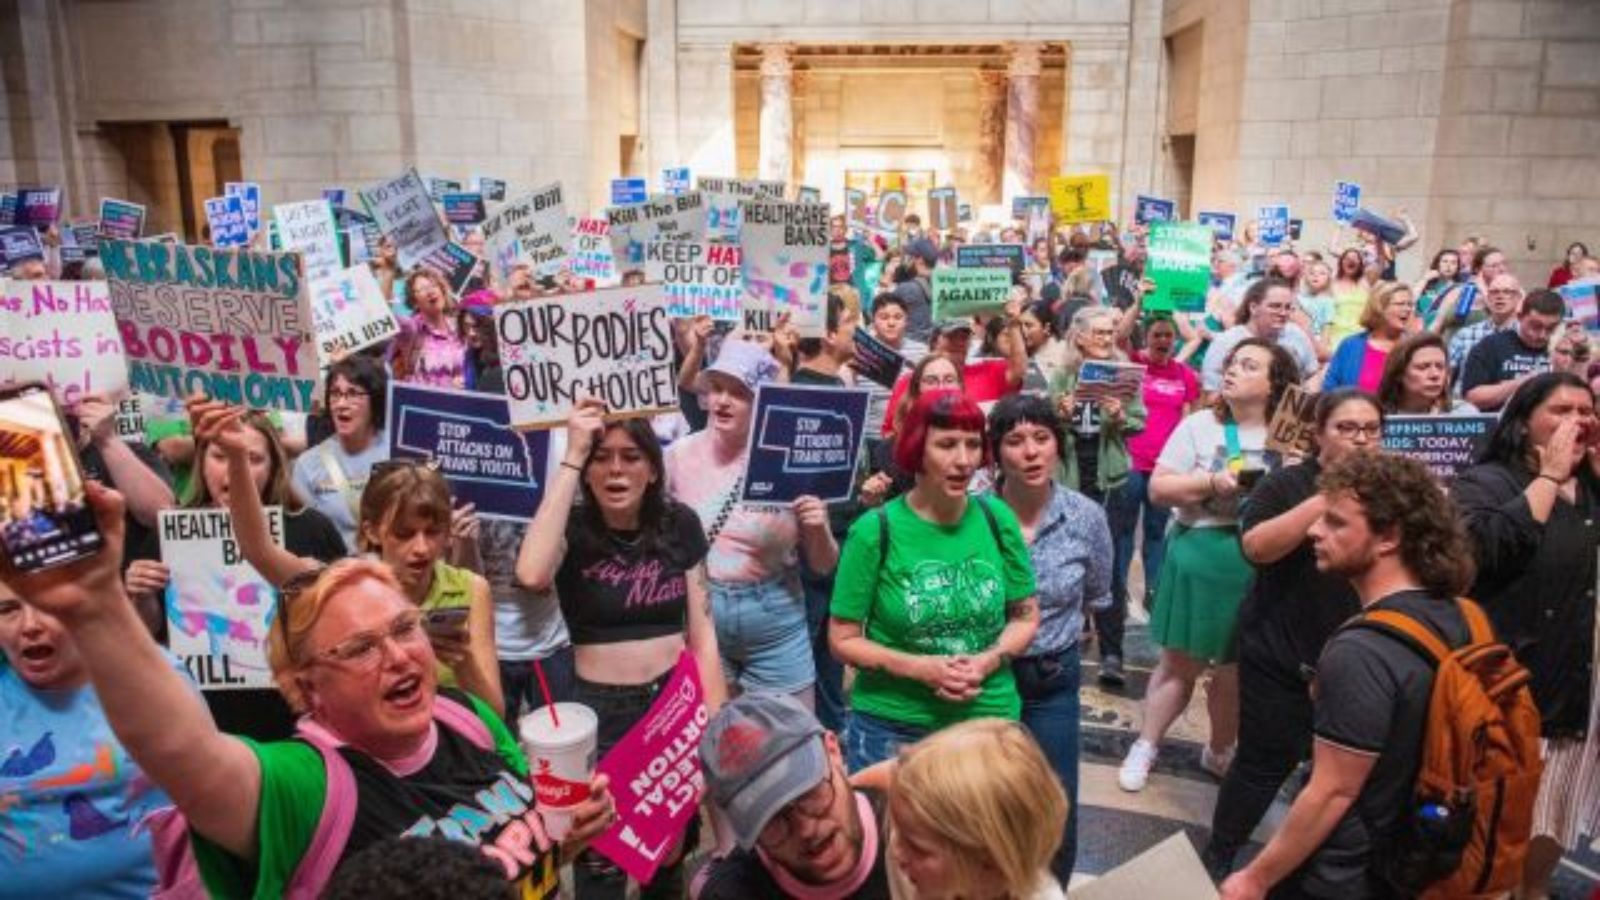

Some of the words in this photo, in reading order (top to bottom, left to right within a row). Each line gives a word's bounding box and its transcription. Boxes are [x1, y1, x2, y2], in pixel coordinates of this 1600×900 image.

[533, 187, 561, 211] Bill
[608, 207, 639, 226] Kill
[642, 203, 673, 220] The
[676, 191, 703, 212] Bill
[744, 202, 828, 226] HEALTHCARE
[784, 225, 828, 246] BANS
[647, 242, 701, 262] KEEP
[664, 264, 706, 284] OUT
[32, 284, 69, 316] No
[744, 308, 781, 333] KIL
[96, 332, 119, 355] in
[118, 319, 305, 375] BODILY
[501, 304, 572, 346] OUR
[570, 306, 667, 367] BODIES
[506, 362, 571, 406] OUR
[437, 422, 470, 437] STOP
[1438, 422, 1486, 434] TRANS
[436, 441, 490, 457] ATTACKS
[494, 445, 514, 458] ON
[1382, 437, 1415, 449] IDS:
[436, 455, 476, 472] TRANS
[164, 512, 280, 541] HEALTHE
